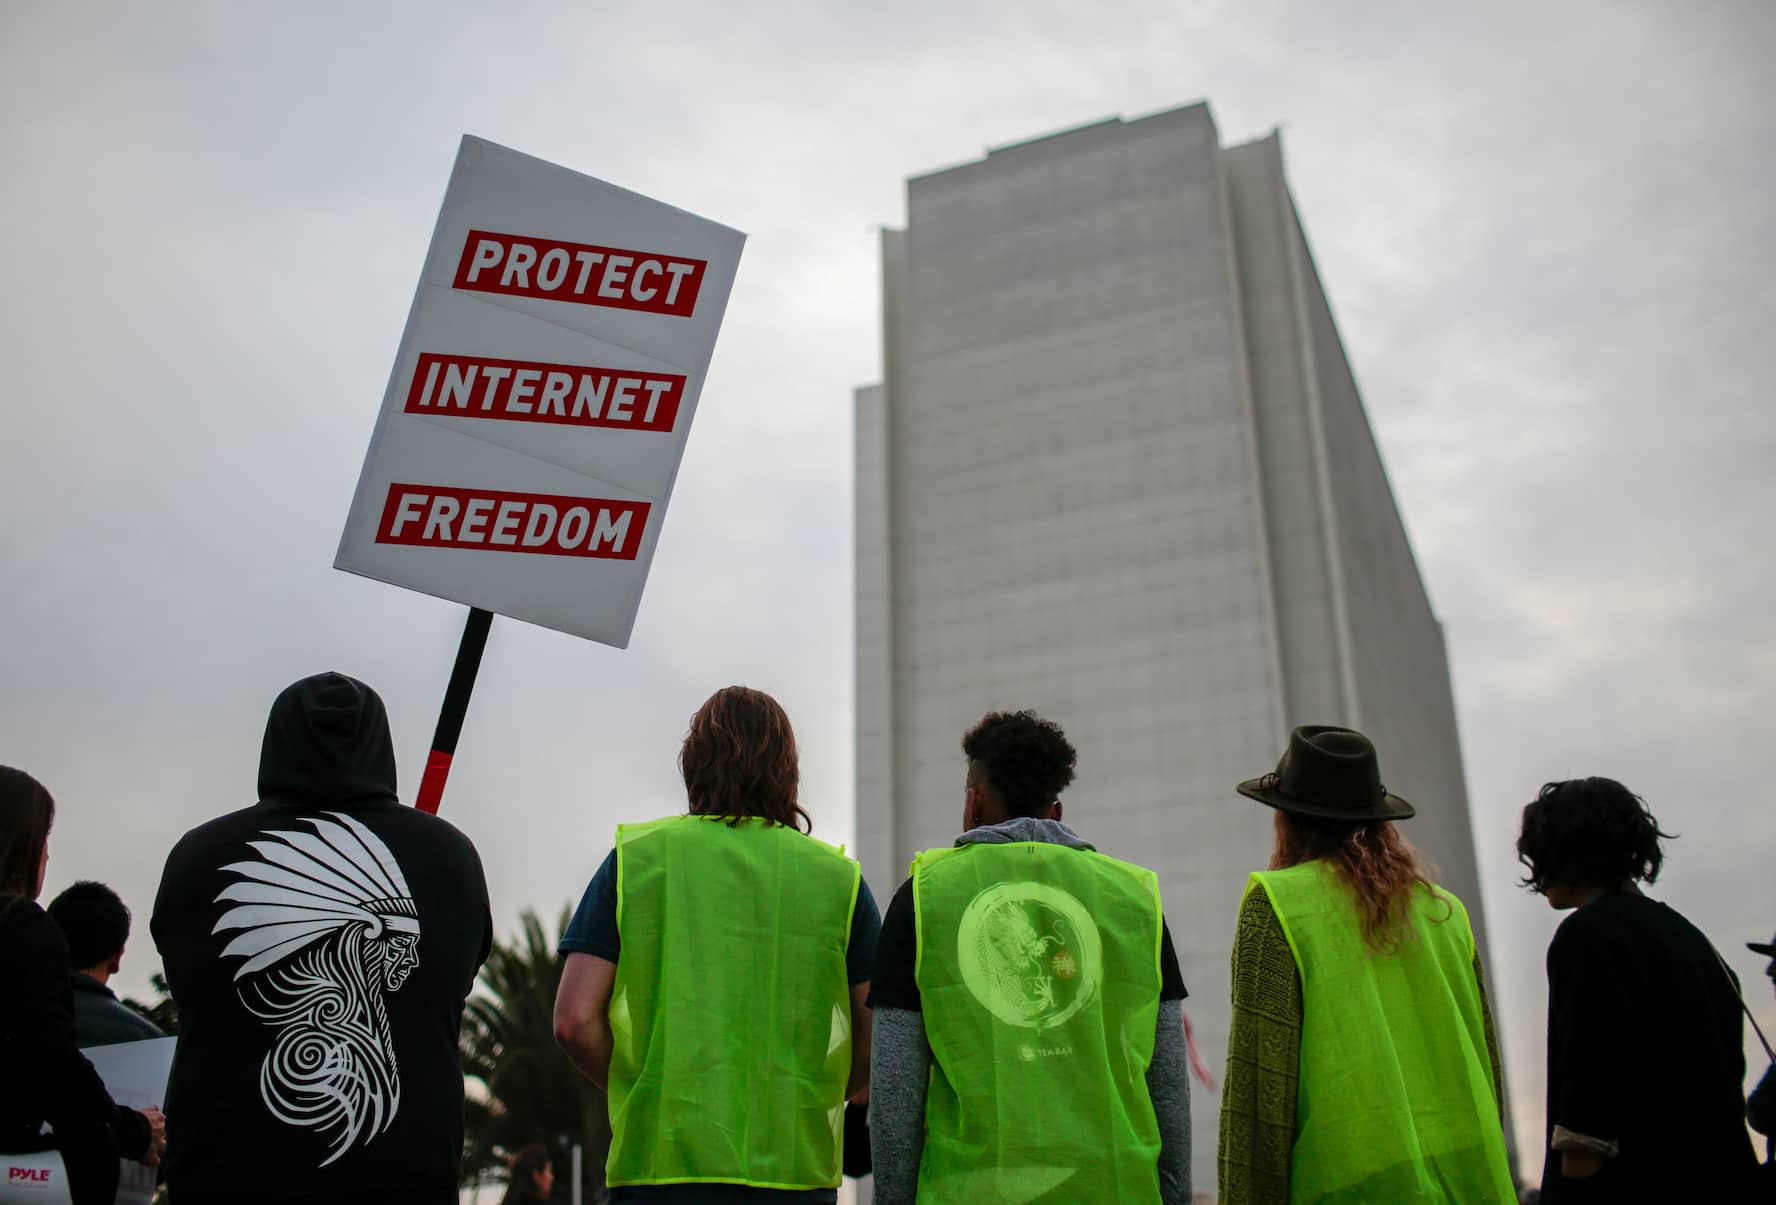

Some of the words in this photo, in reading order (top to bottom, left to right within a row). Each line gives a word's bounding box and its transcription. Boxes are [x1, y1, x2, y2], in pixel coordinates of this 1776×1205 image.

[467, 240, 694, 304] PROTECT
[420, 363, 672, 422] INTERNET
[390, 494, 633, 552] FREEDOM
[9, 1167, 51, 1181] PYLE
